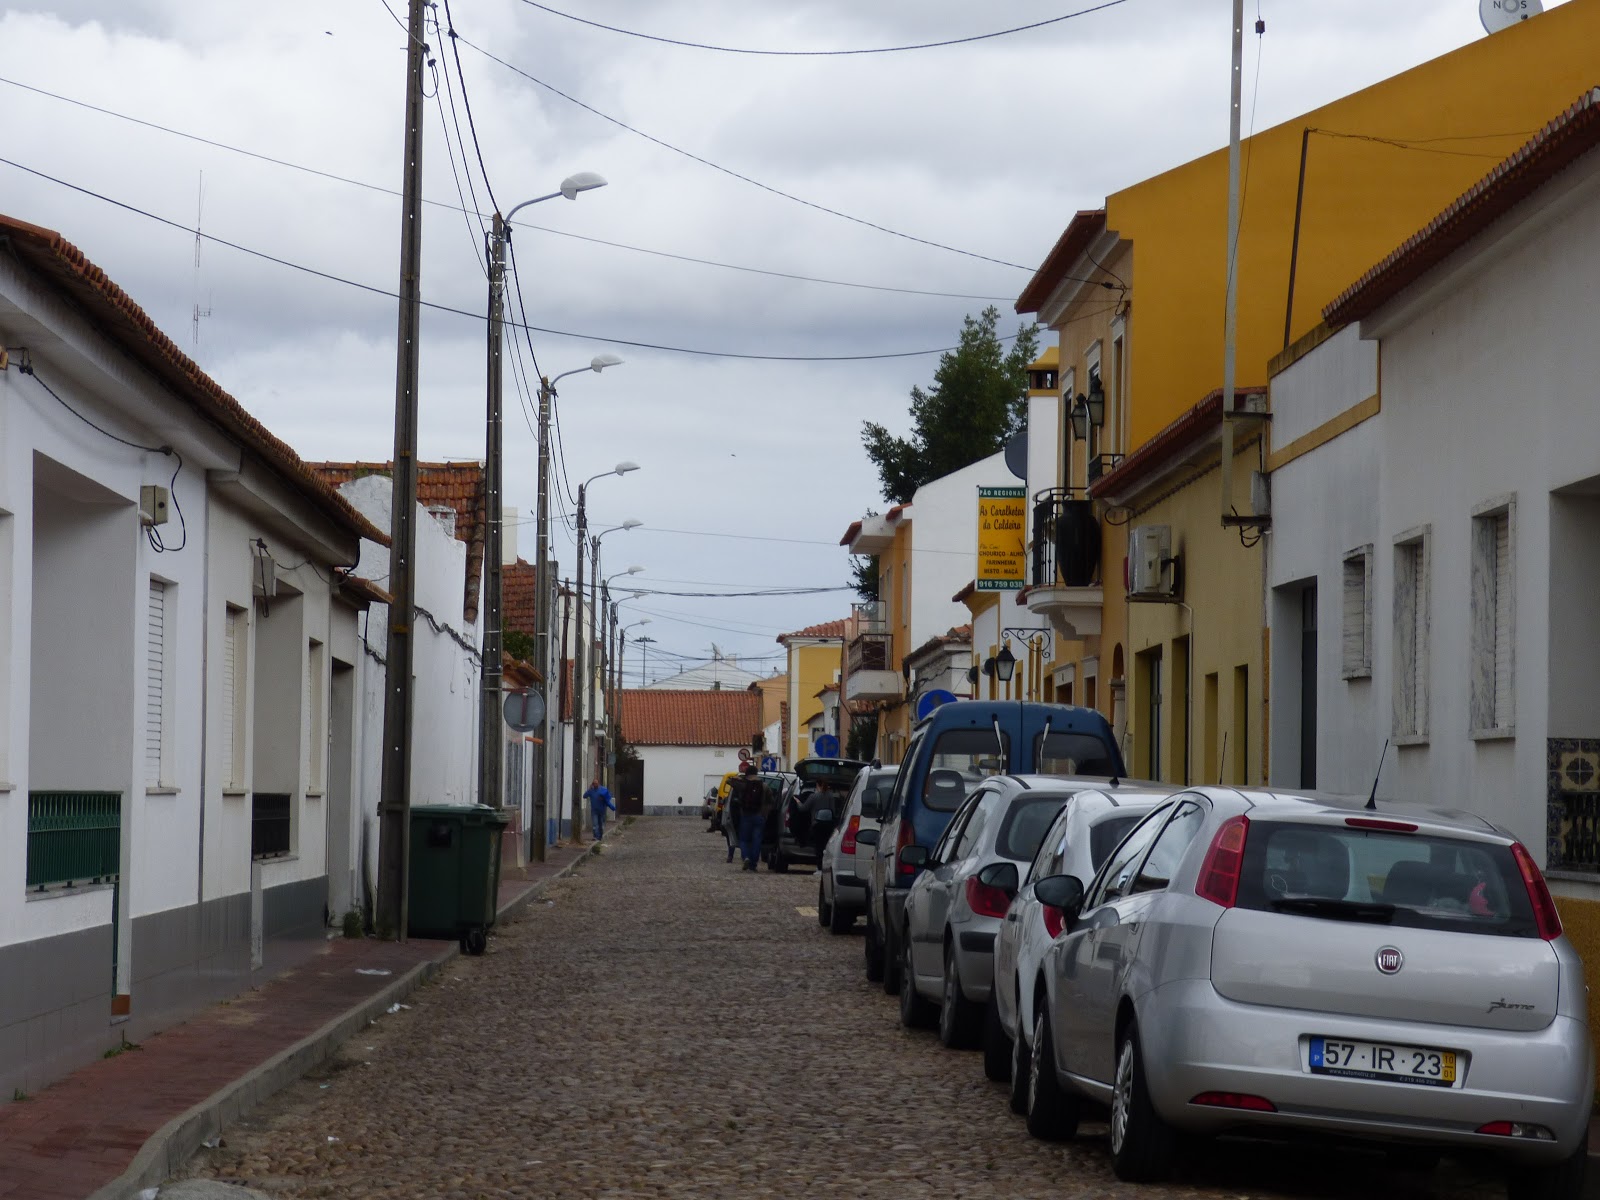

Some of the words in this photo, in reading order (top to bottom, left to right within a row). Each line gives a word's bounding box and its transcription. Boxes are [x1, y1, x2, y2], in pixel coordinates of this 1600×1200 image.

[1493, 0, 1527, 13] NOS
[980, 505, 988, 517] As
[983, 519, 991, 530] da
[1382, 954, 1398, 967] FIAT
[1444, 1055, 1454, 1064] 10
[1443, 1069, 1453, 1079] 01
